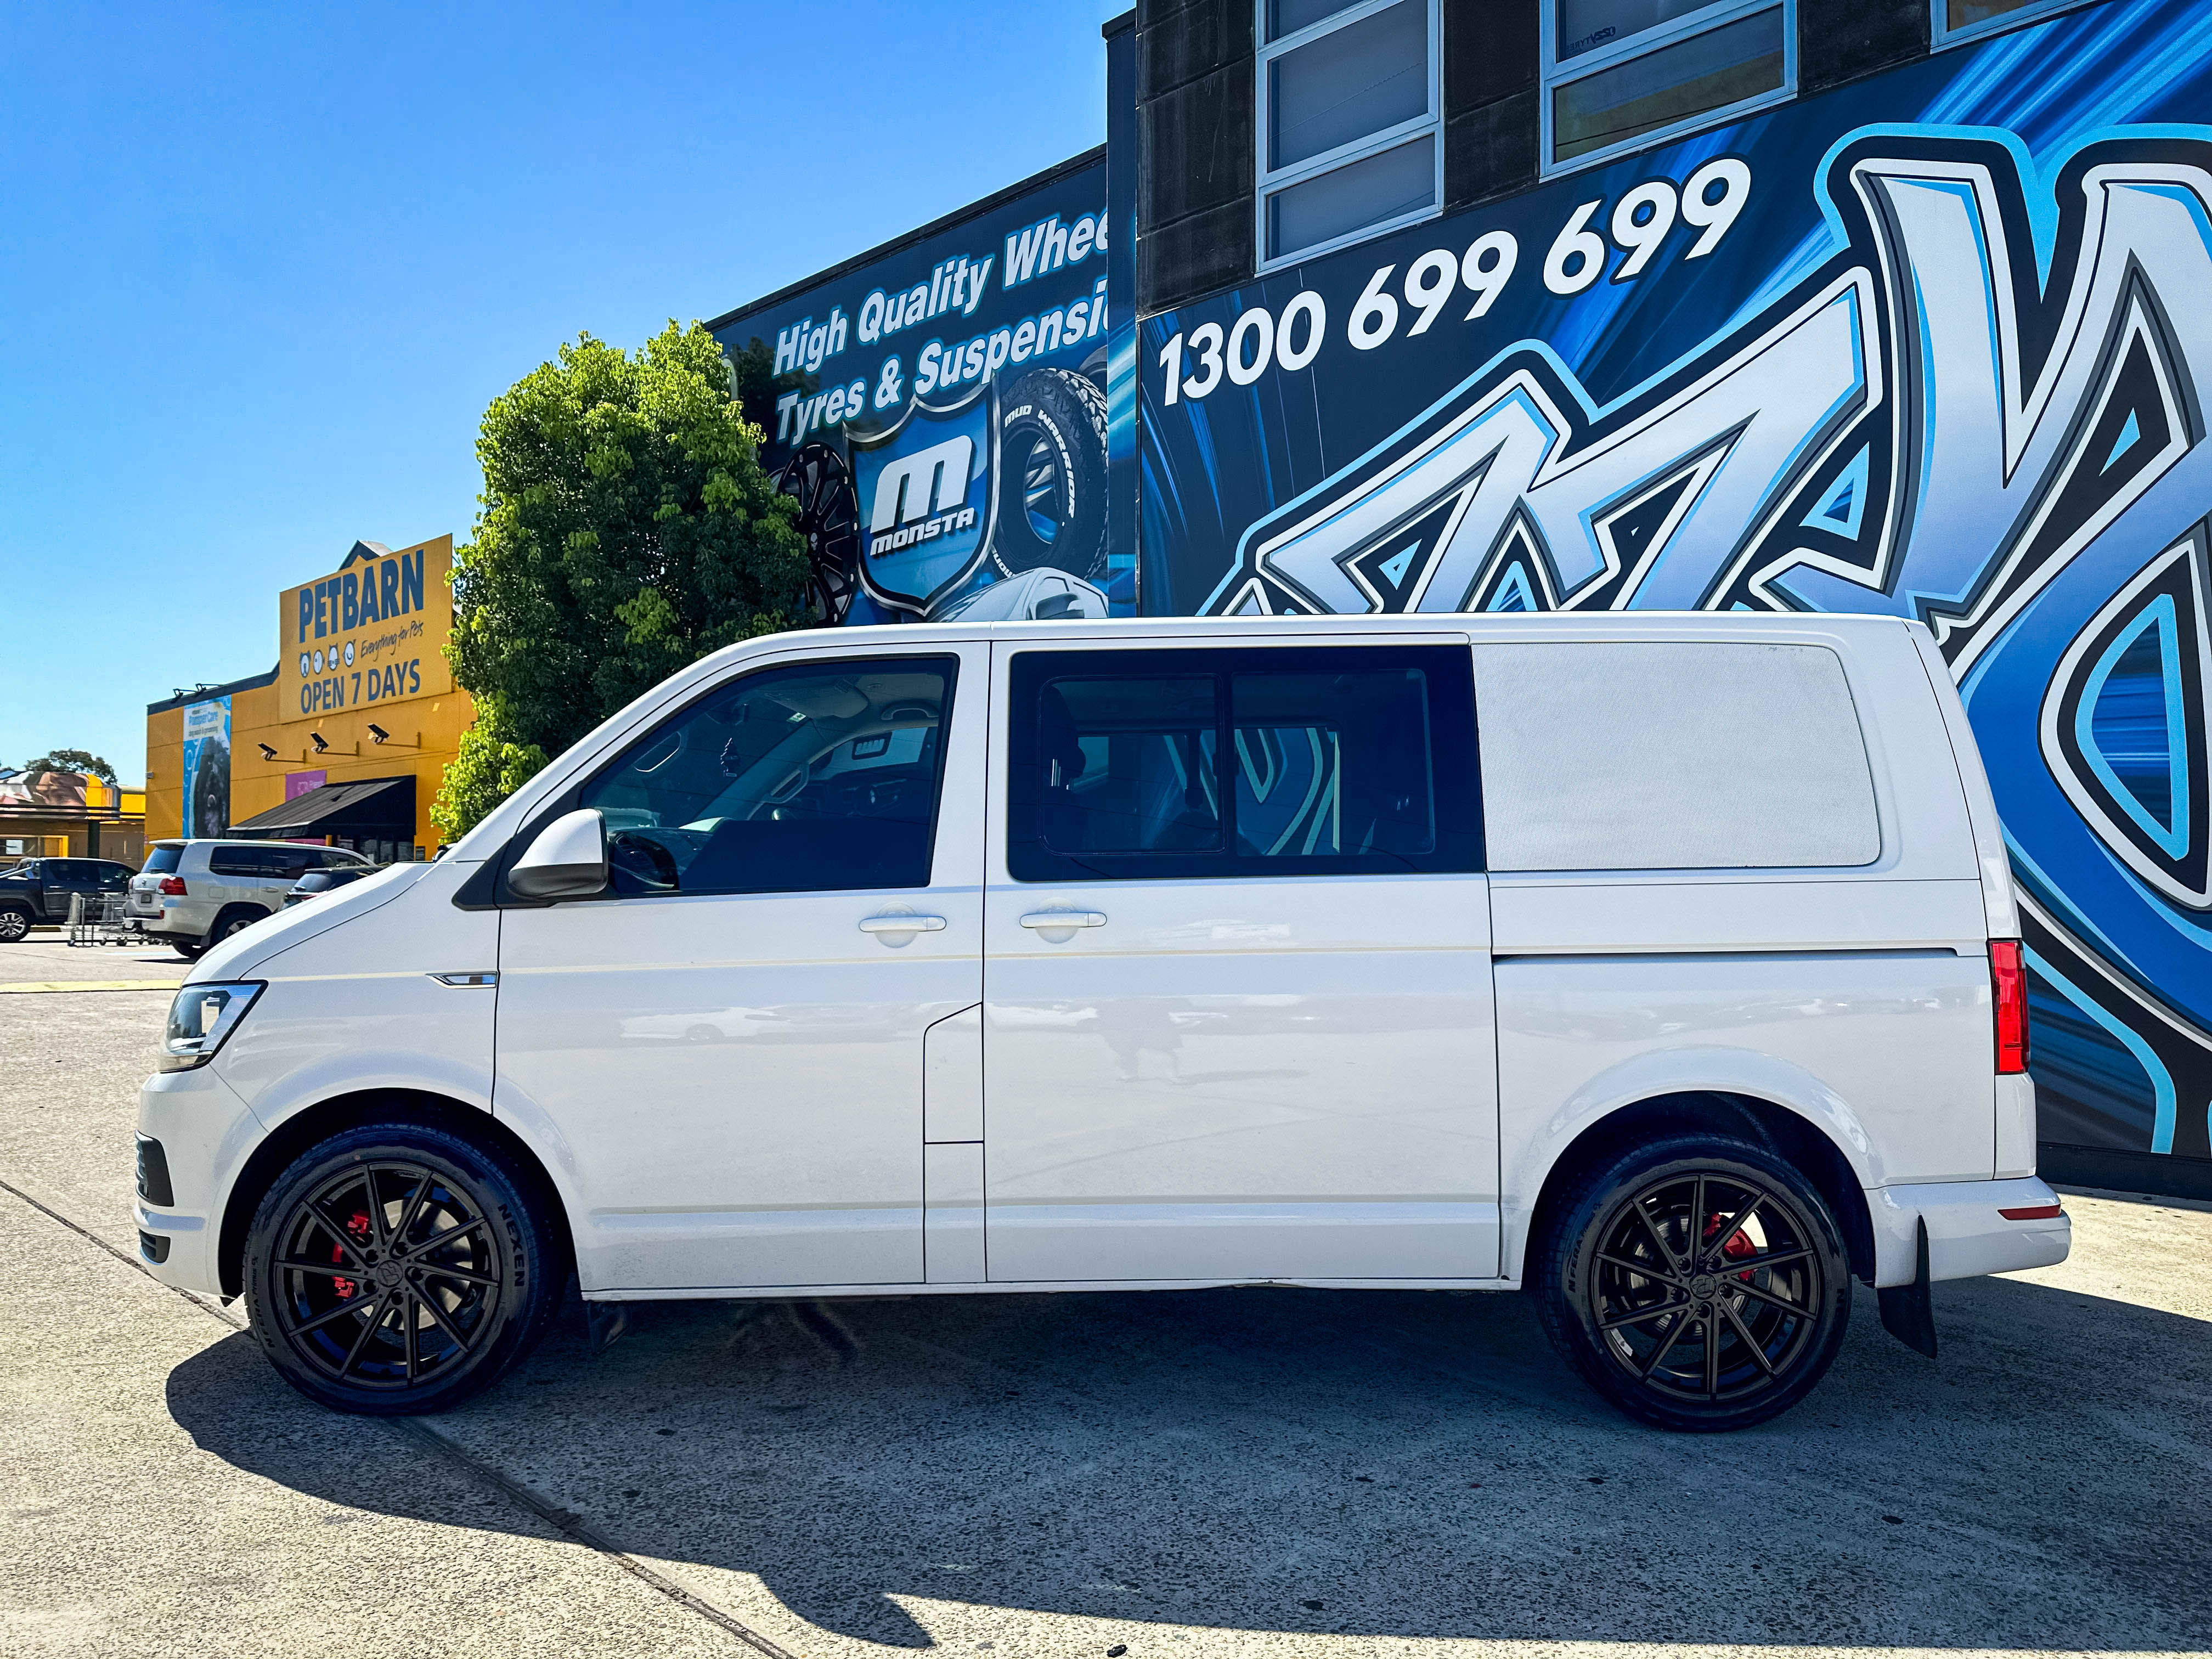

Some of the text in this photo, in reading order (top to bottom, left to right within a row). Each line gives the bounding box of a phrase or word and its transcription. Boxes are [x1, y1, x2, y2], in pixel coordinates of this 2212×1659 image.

[773, 308, 847, 376] High
[858, 257, 993, 343] Quality
[1158, 159, 1751, 406] 1300 699 699
[776, 279, 1108, 446] Tyres & Suspensi
[1005, 404, 1076, 518] MUD WARRIOR
[870, 507, 975, 556] MONSTA
[298, 549, 424, 644] PETBARN
[360, 619, 424, 662] Everything for Pets
[300, 658, 421, 714] OPEN 7 DAYS
[498, 1203, 525, 1286] NEXEN
